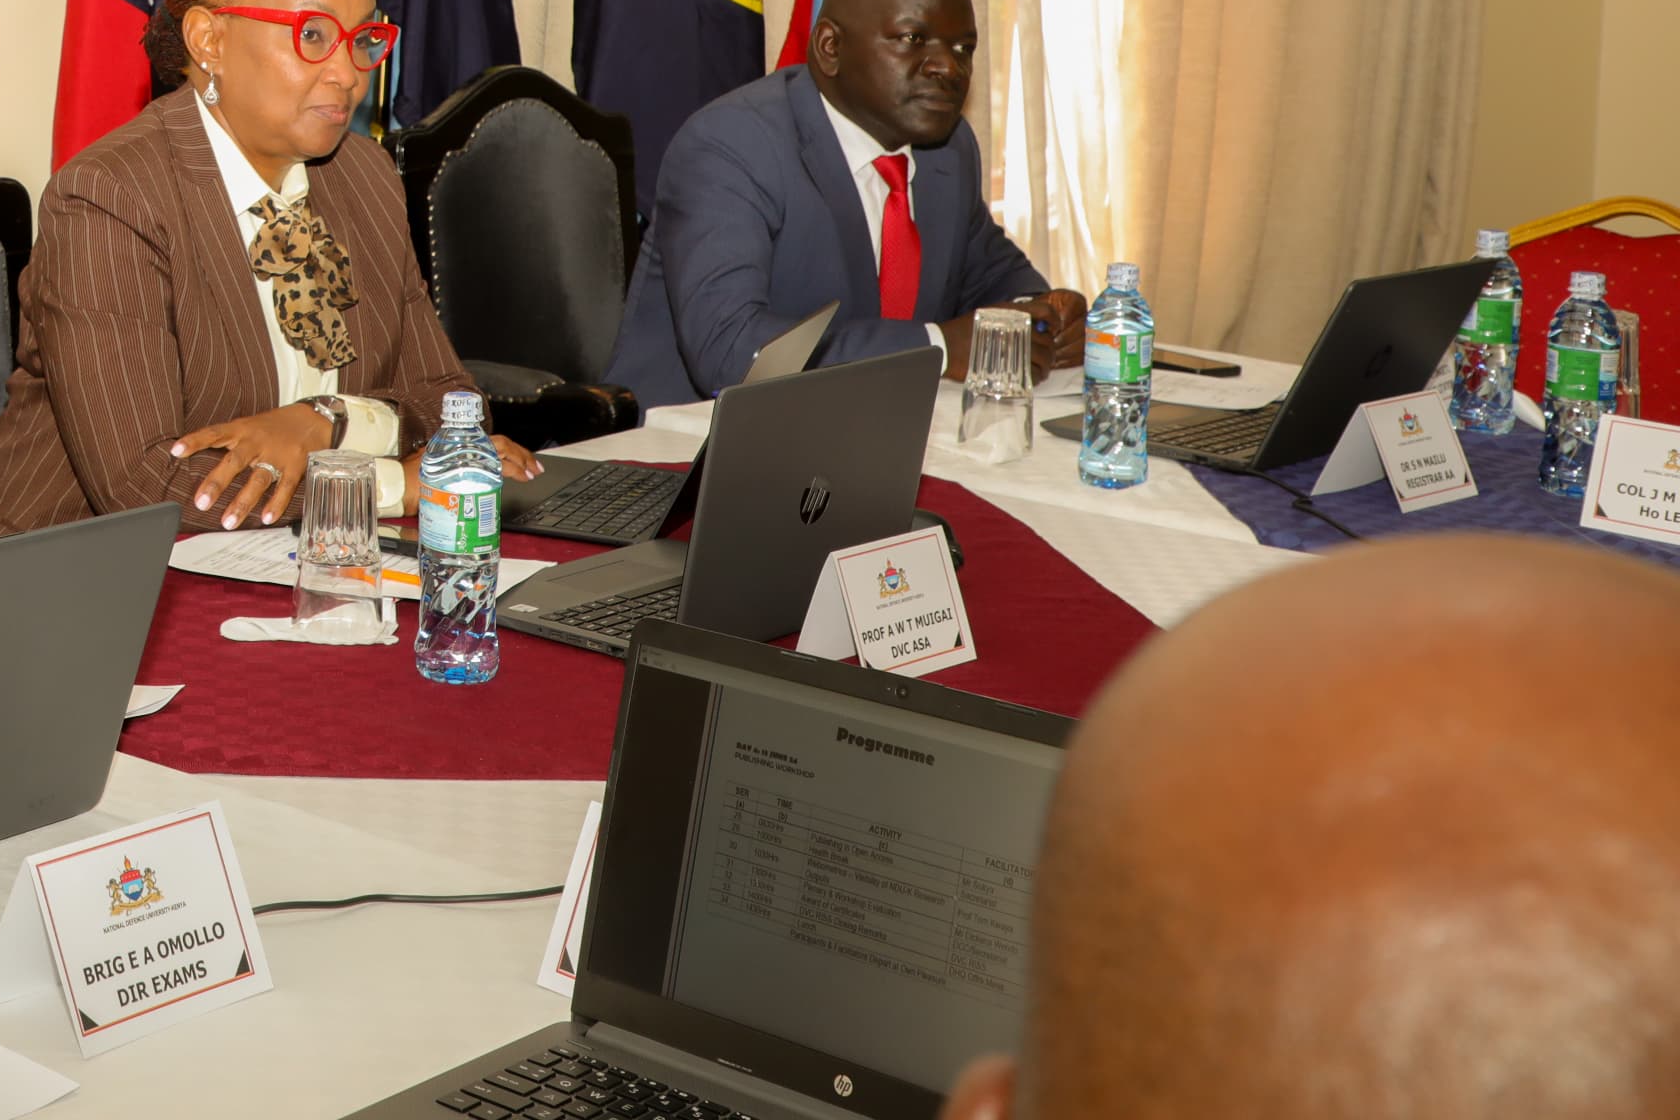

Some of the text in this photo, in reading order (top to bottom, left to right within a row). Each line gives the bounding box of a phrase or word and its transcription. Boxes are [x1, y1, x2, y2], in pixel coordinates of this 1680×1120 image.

[1424, 454, 1447, 468] MAILU
[1406, 469, 1456, 489] REGISTRAR AA
[1617, 483, 1675, 503] COL J M
[1640, 505, 1659, 519] Ho
[861, 608, 953, 644] PROF A W T MUIGAI
[891, 636, 931, 659] DVC ASA
[836, 726, 936, 766] Programme
[734, 751, 815, 779] PUBLISHING WORKSHOP
[776, 797, 792, 809] TIME
[868, 823, 902, 840] ACTIVITY
[985, 856, 1033, 878] FACILITATO
[103, 922, 125, 934] NATIONAL
[125, 916, 146, 927] DEFENCE
[83, 921, 225, 985] BRIG E A OMOLLO
[117, 960, 207, 1007] DIR EXAMS
[834, 1074, 853, 1096] hp
